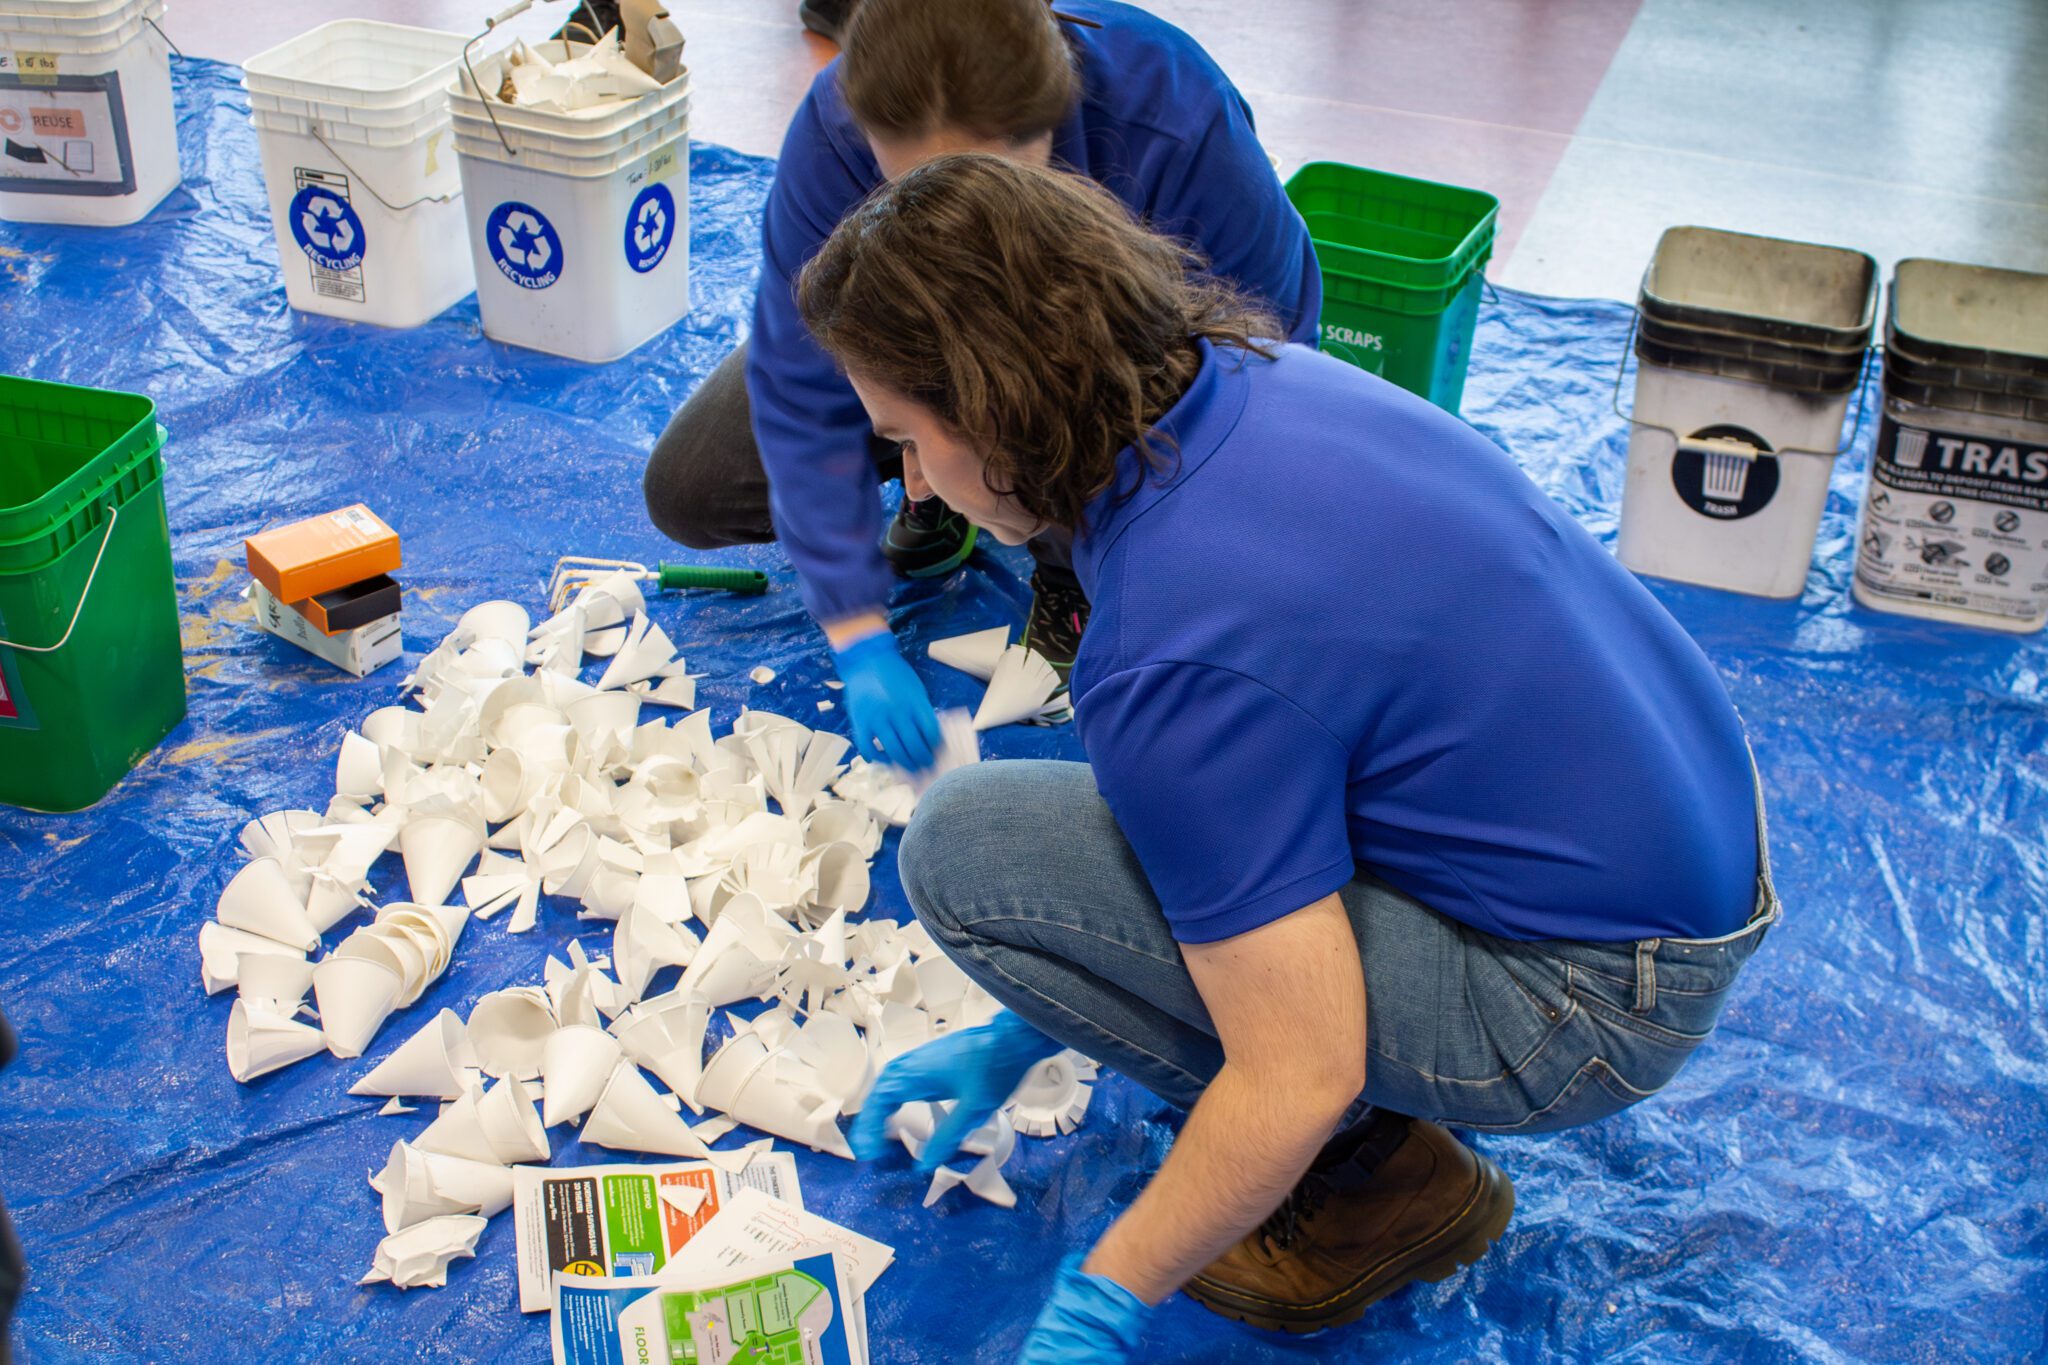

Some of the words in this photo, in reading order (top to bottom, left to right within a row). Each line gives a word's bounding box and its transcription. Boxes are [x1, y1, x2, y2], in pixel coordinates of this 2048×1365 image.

[33, 115, 73, 129] REUSE
[303, 243, 361, 270] RECYCLING
[498, 258, 556, 289] RECYCLING
[1326, 325, 1383, 351] SCRAPS
[1704, 501, 1738, 515] TRASH
[635, 1327, 649, 1365] FLOOR
